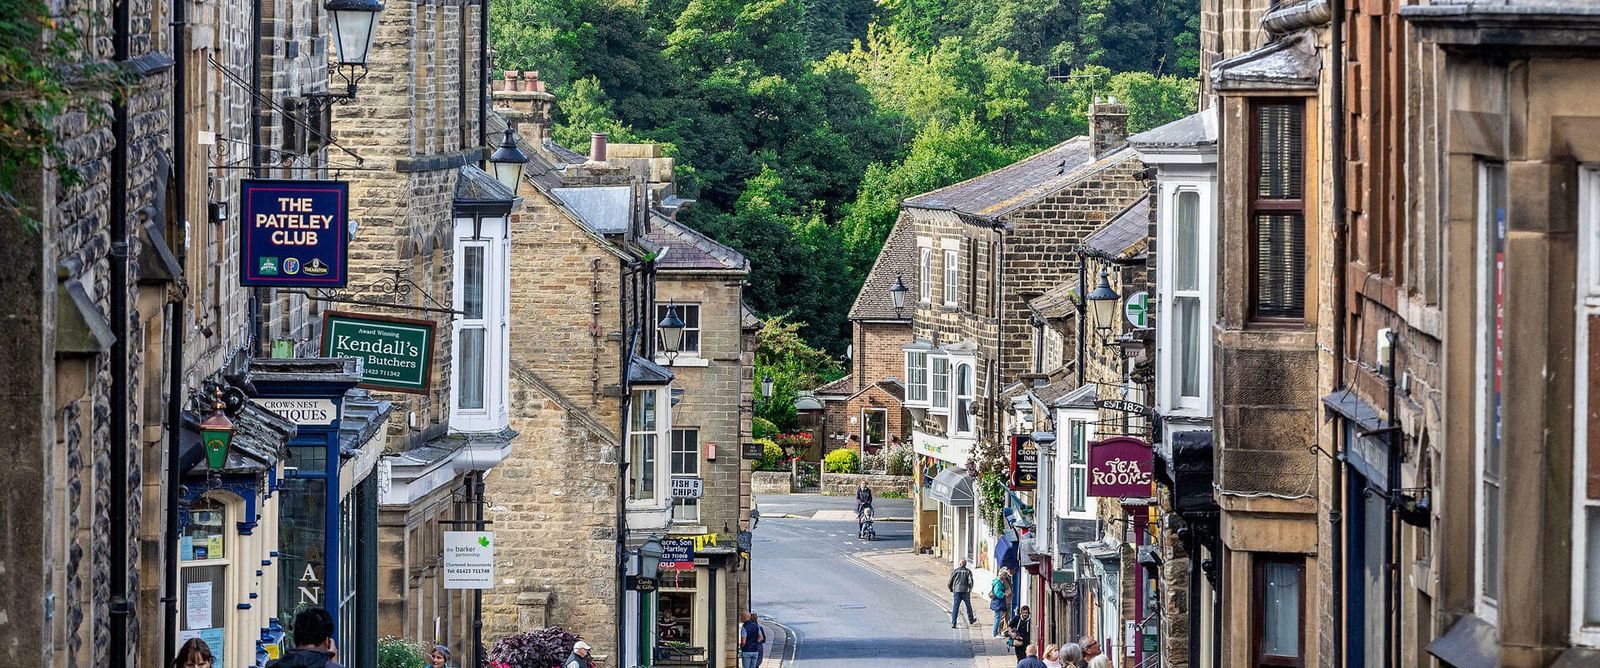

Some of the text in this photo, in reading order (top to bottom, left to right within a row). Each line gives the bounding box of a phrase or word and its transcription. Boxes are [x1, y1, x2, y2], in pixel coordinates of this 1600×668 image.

[278, 197, 313, 212] THE
[255, 213, 334, 229] PATELEY
[271, 231, 318, 245] CLUB
[377, 330, 400, 338] Winning
[336, 335, 419, 357] Kendall's
[368, 355, 417, 369] Butchers
[380, 369, 401, 377] 711342
[1103, 401, 1144, 412] EST. 1827
[273, 410, 327, 422] TIQUES
[1105, 458, 1140, 473] TEA
[1092, 467, 1151, 485] ROOMS
[671, 480, 689, 488] FISH
[672, 488, 698, 497] CHIPS
[663, 545, 688, 554] Hartley
